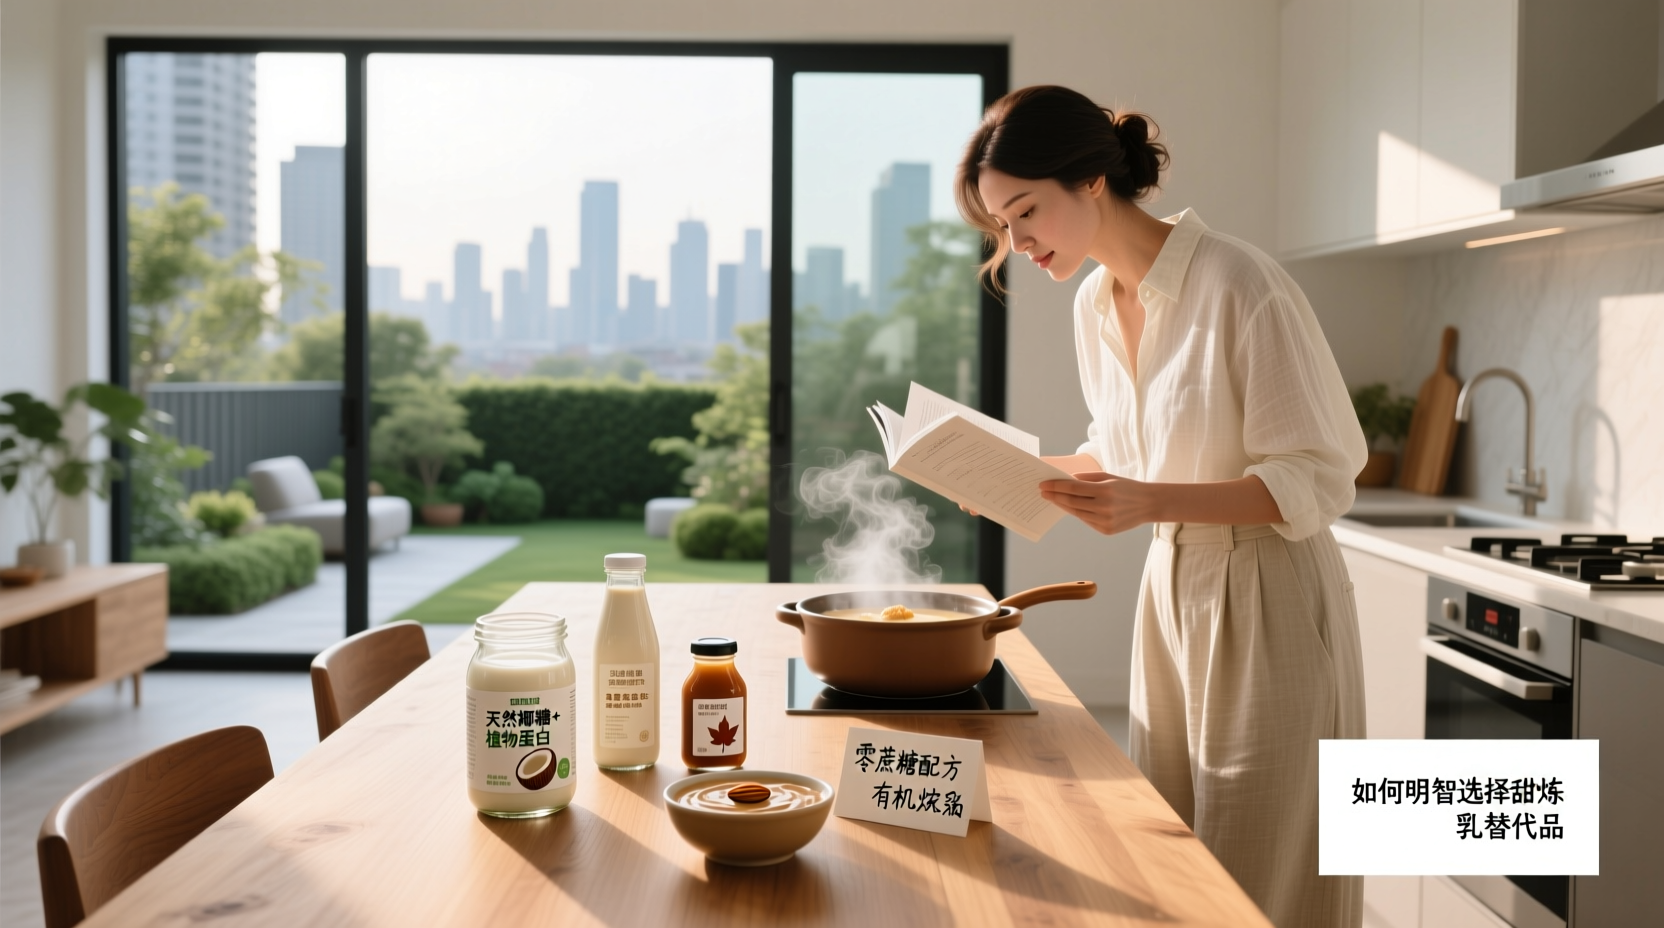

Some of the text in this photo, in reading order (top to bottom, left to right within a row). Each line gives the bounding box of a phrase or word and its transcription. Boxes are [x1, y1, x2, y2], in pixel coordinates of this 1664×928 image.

[855, 743, 962, 781] 零蔗糖配方
